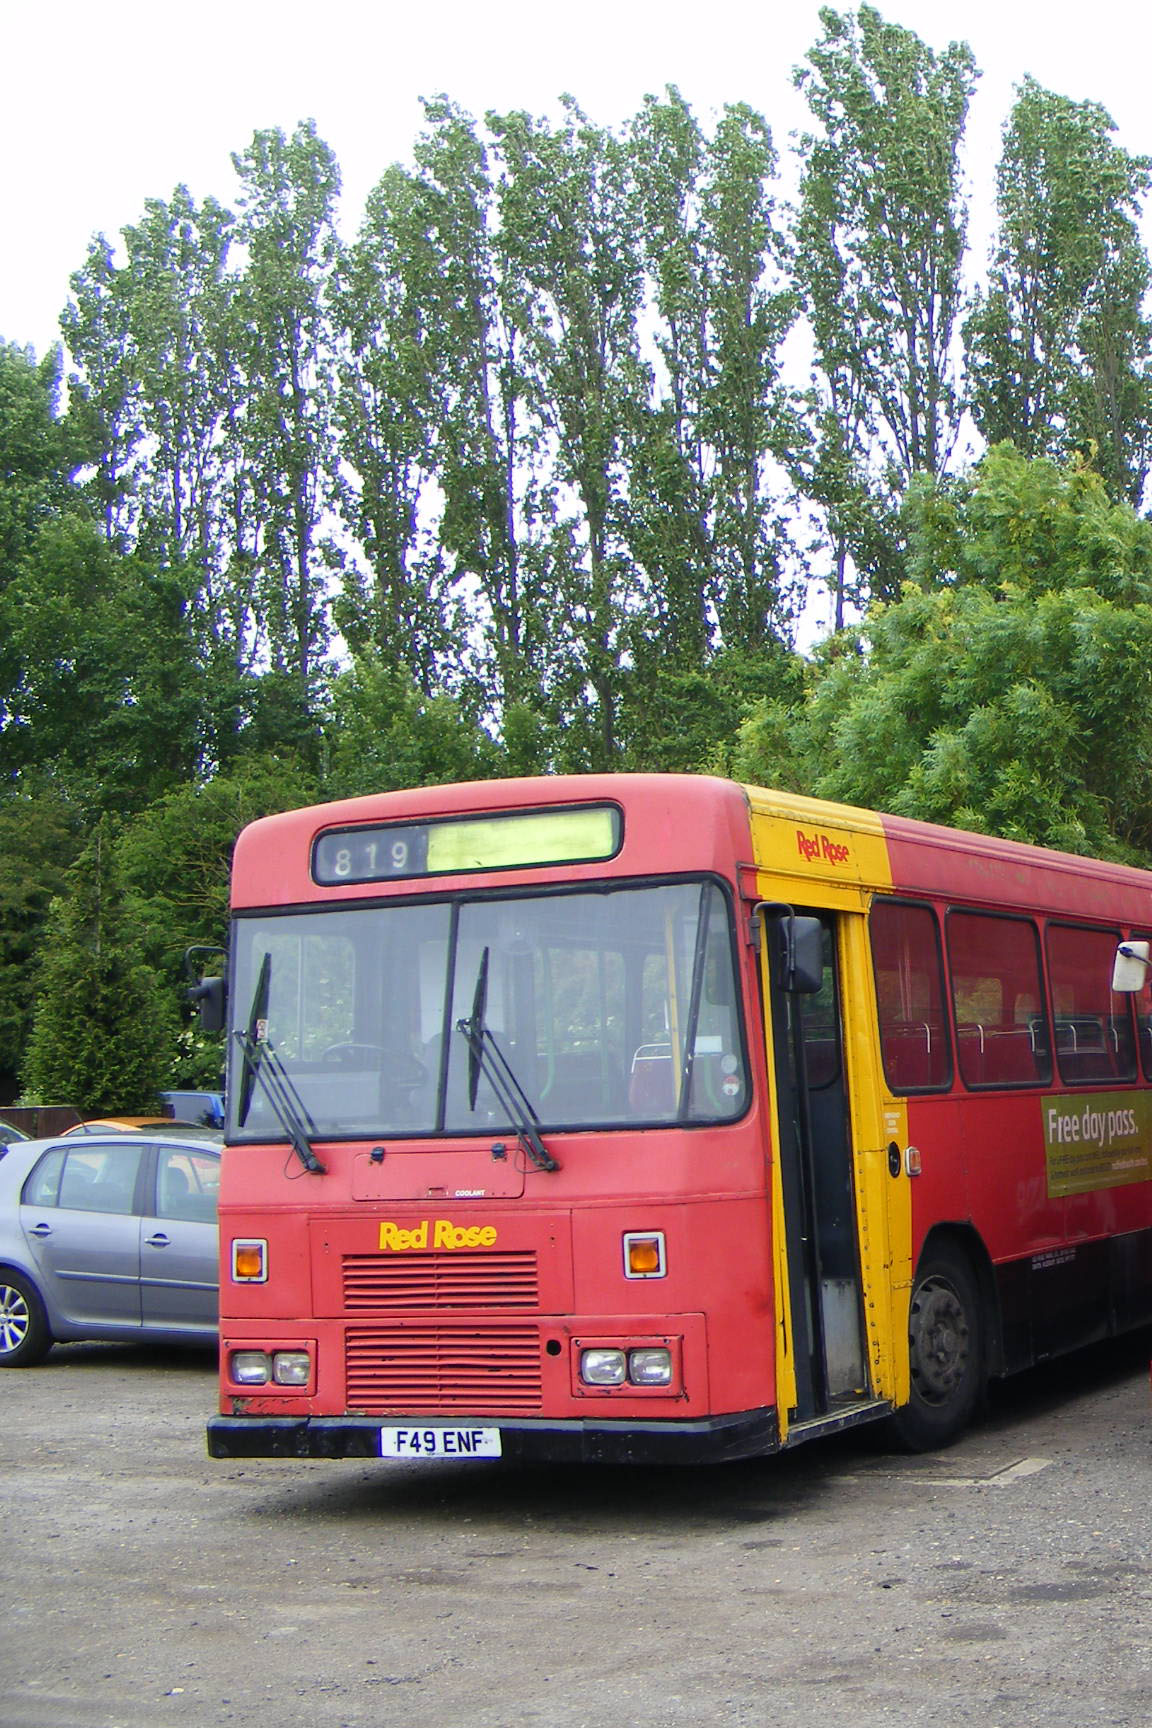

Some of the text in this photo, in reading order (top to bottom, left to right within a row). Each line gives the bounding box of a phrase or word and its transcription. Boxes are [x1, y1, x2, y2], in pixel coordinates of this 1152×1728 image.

[335, 841, 408, 876] 819
[796, 830, 849, 866] Red Rose
[1048, 1108, 1080, 1144] Free
[1082, 1104, 1105, 1147] day
[1108, 1108, 1139, 1145] pass.
[455, 1189, 486, 1197] COOLANT
[379, 1219, 497, 1251] Red Rose
[397, 1431, 484, 1453] F49 ENF
